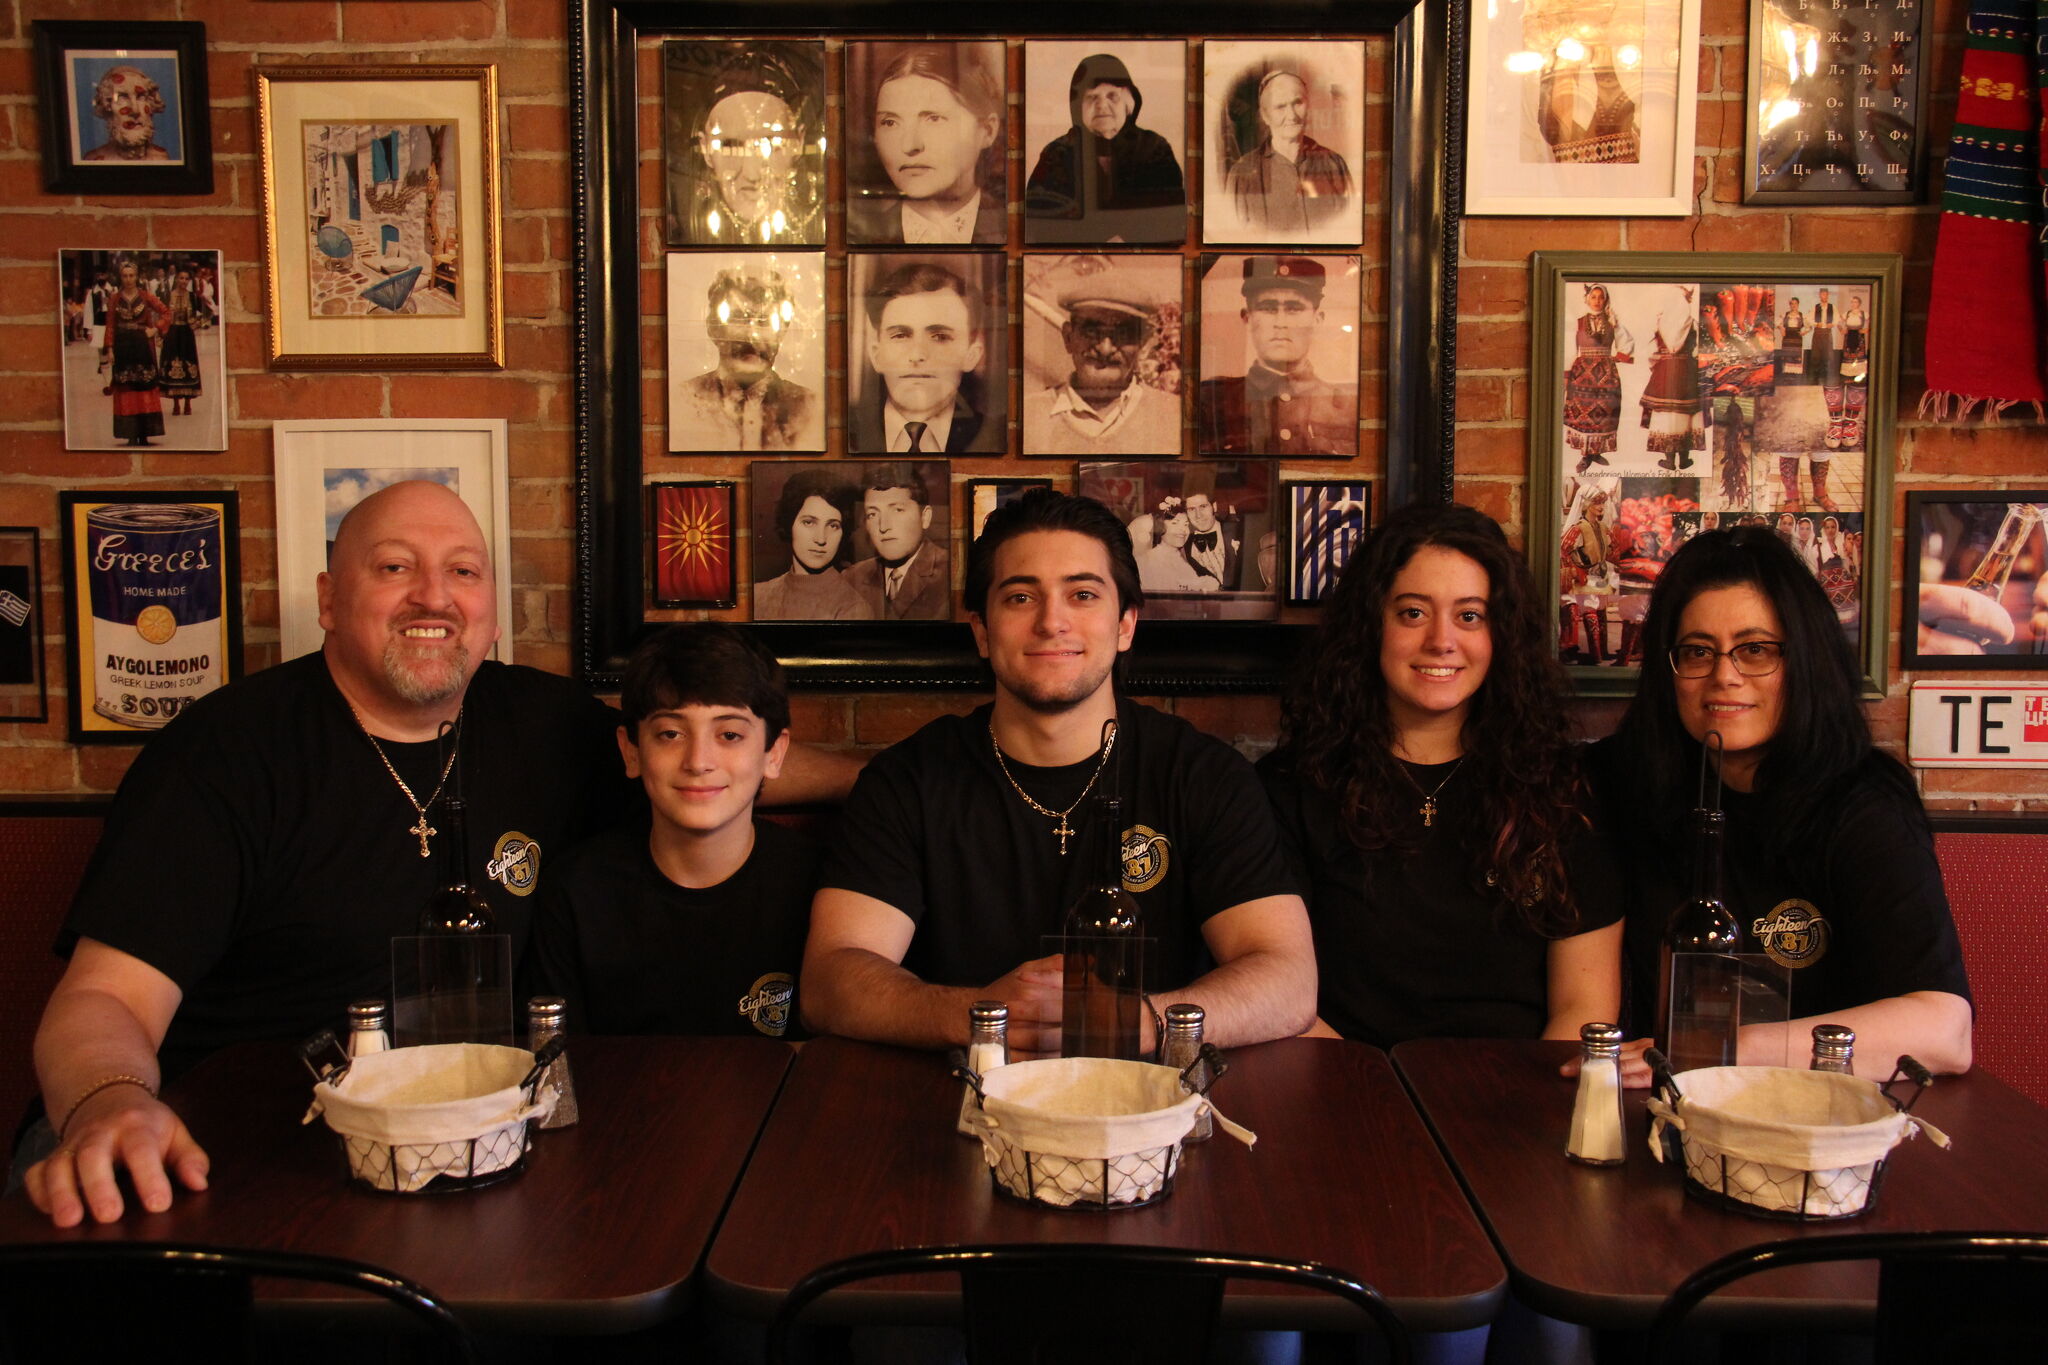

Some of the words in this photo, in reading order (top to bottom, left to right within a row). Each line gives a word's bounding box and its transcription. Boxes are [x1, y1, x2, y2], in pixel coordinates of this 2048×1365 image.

[94, 534, 212, 573] Greece's
[124, 586, 154, 597] HOME
[157, 586, 187, 597] MADE
[106, 654, 209, 675] AYGOLEMONO
[110, 674, 142, 689] GREEK
[144, 678, 176, 689] LEMON
[179, 674, 205, 688] SOUP
[487, 844, 537, 885] Eighteen
[1126, 852, 1151, 877] 87
[1753, 916, 1821, 947] Eighteen
[1781, 932, 1809, 952] 87
[739, 986, 793, 1022] Eighteen
